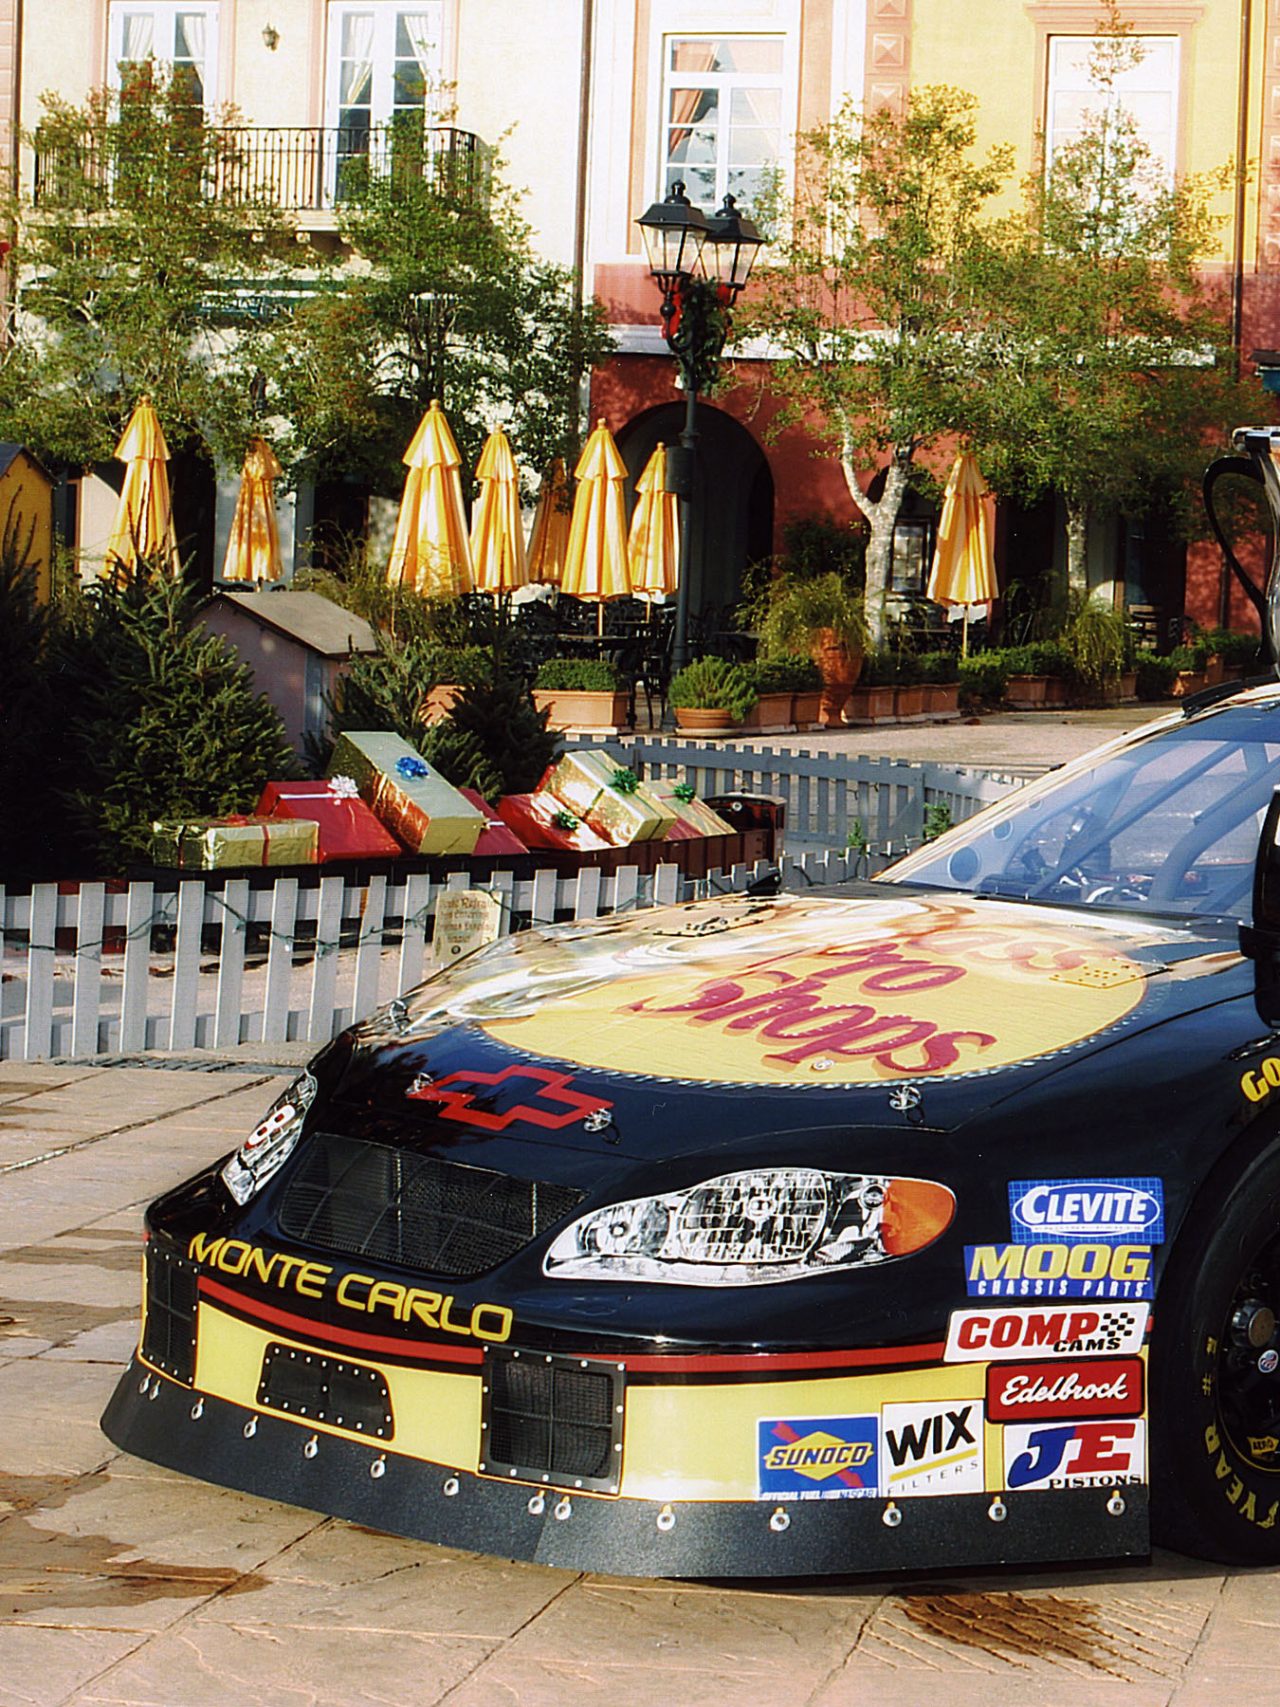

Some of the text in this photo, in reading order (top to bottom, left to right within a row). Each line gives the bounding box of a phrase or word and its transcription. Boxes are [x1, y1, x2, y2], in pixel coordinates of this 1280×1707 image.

[632, 970, 997, 1074] Shops
[246, 1104, 297, 1147] 8
[1021, 1185, 1150, 1224] CLEVITE
[969, 1243, 1151, 1281] MOOG
[188, 1232, 514, 1343] MONTE CARLO
[977, 1279, 1144, 1298] CHASSIS PARTS
[957, 1312, 1100, 1350] COMP
[1053, 1337, 1122, 1353] CAMS
[1000, 1372, 1129, 1406] Edelbrock
[885, 1405, 976, 1467] WIX
[769, 1444, 870, 1467] SUNOCO
[1007, 1423, 1136, 1489] JE
[887, 1459, 979, 1496] FILTERS
[1049, 1474, 1142, 1489] PISTONS
